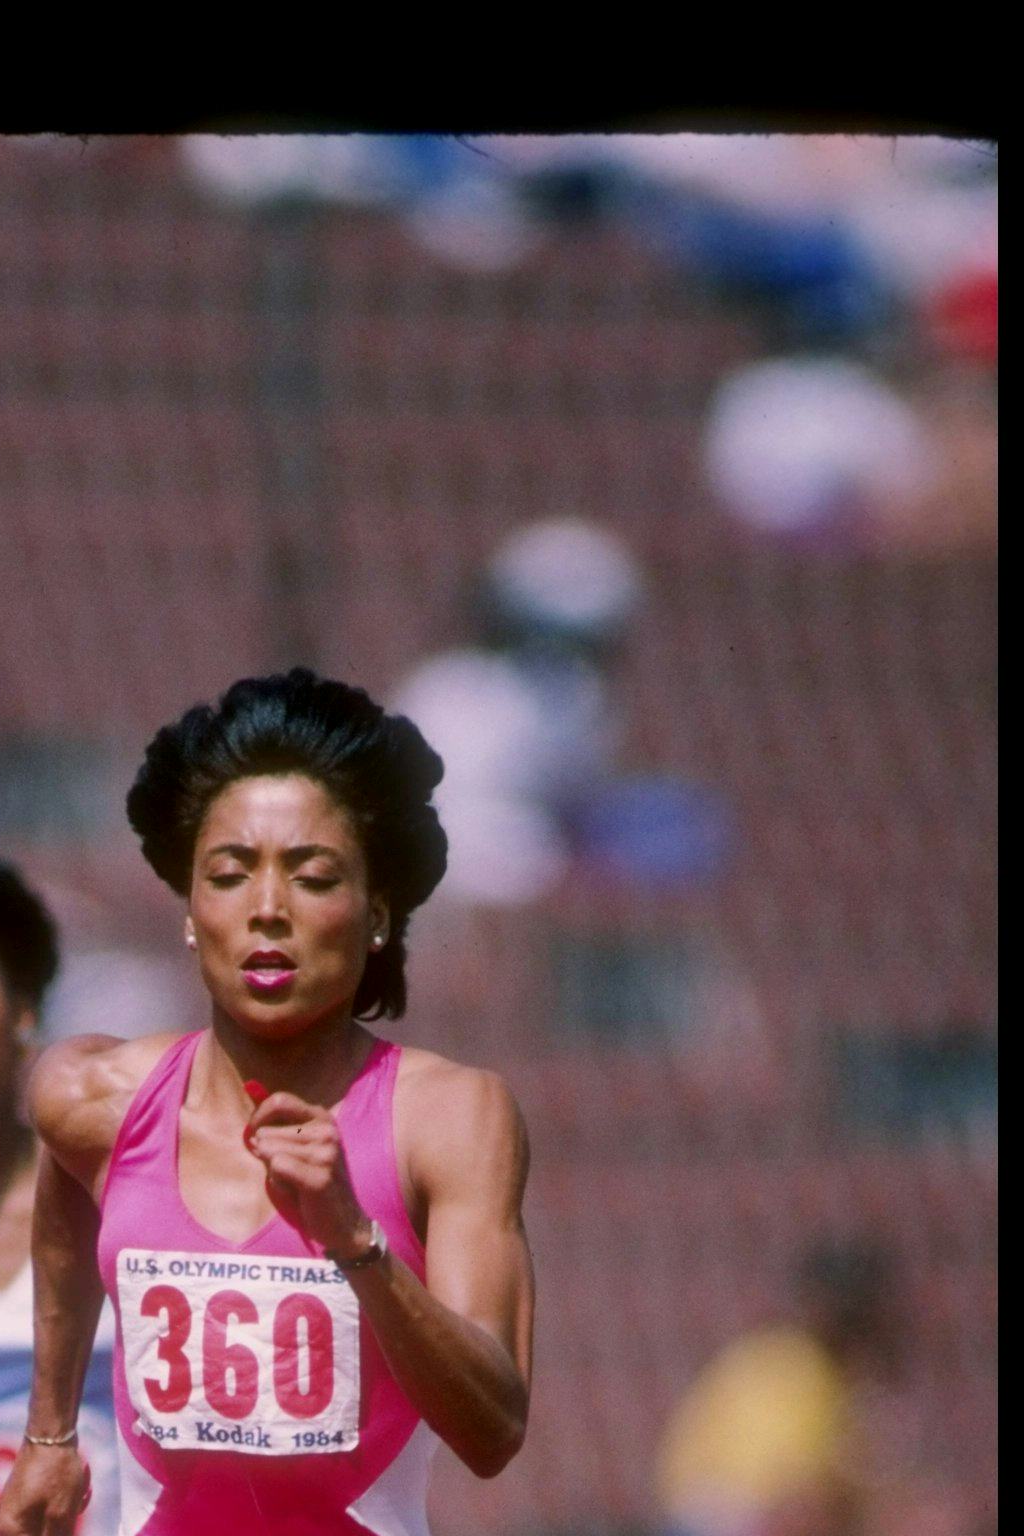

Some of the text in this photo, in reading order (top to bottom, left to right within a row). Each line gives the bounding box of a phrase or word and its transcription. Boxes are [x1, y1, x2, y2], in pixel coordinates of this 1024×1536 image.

[126, 1258, 346, 1284] U.S. OLYMPIC TRIALS
[140, 1284, 334, 1420] 360
[195, 1421, 272, 1448] Kodak
[291, 1430, 344, 1447] 1984
